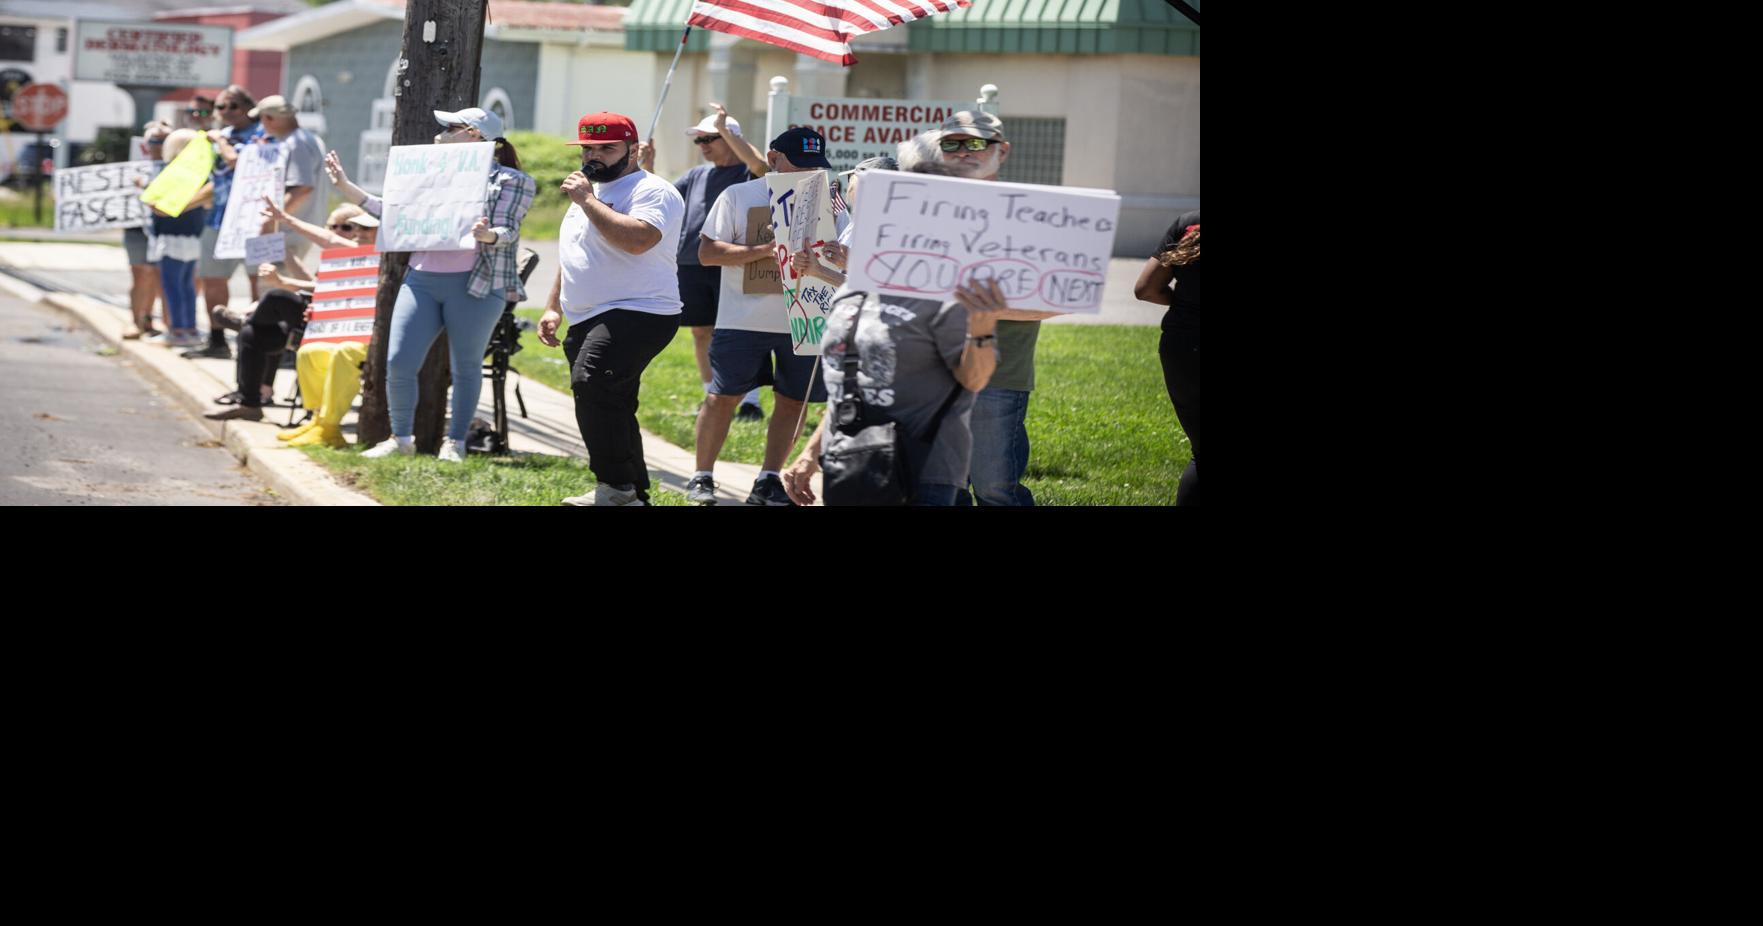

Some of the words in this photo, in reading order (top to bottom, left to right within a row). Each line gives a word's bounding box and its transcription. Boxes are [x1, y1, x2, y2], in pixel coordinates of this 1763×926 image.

[882, 180, 990, 233] Firing
[876, 223, 950, 257] Firing
[960, 229, 1101, 271] Veterans
[801, 286, 818, 303] TAX
[812, 285, 829, 305] THE
[873, 254, 959, 290] YOU
[1051, 274, 1104, 304] NEXT
